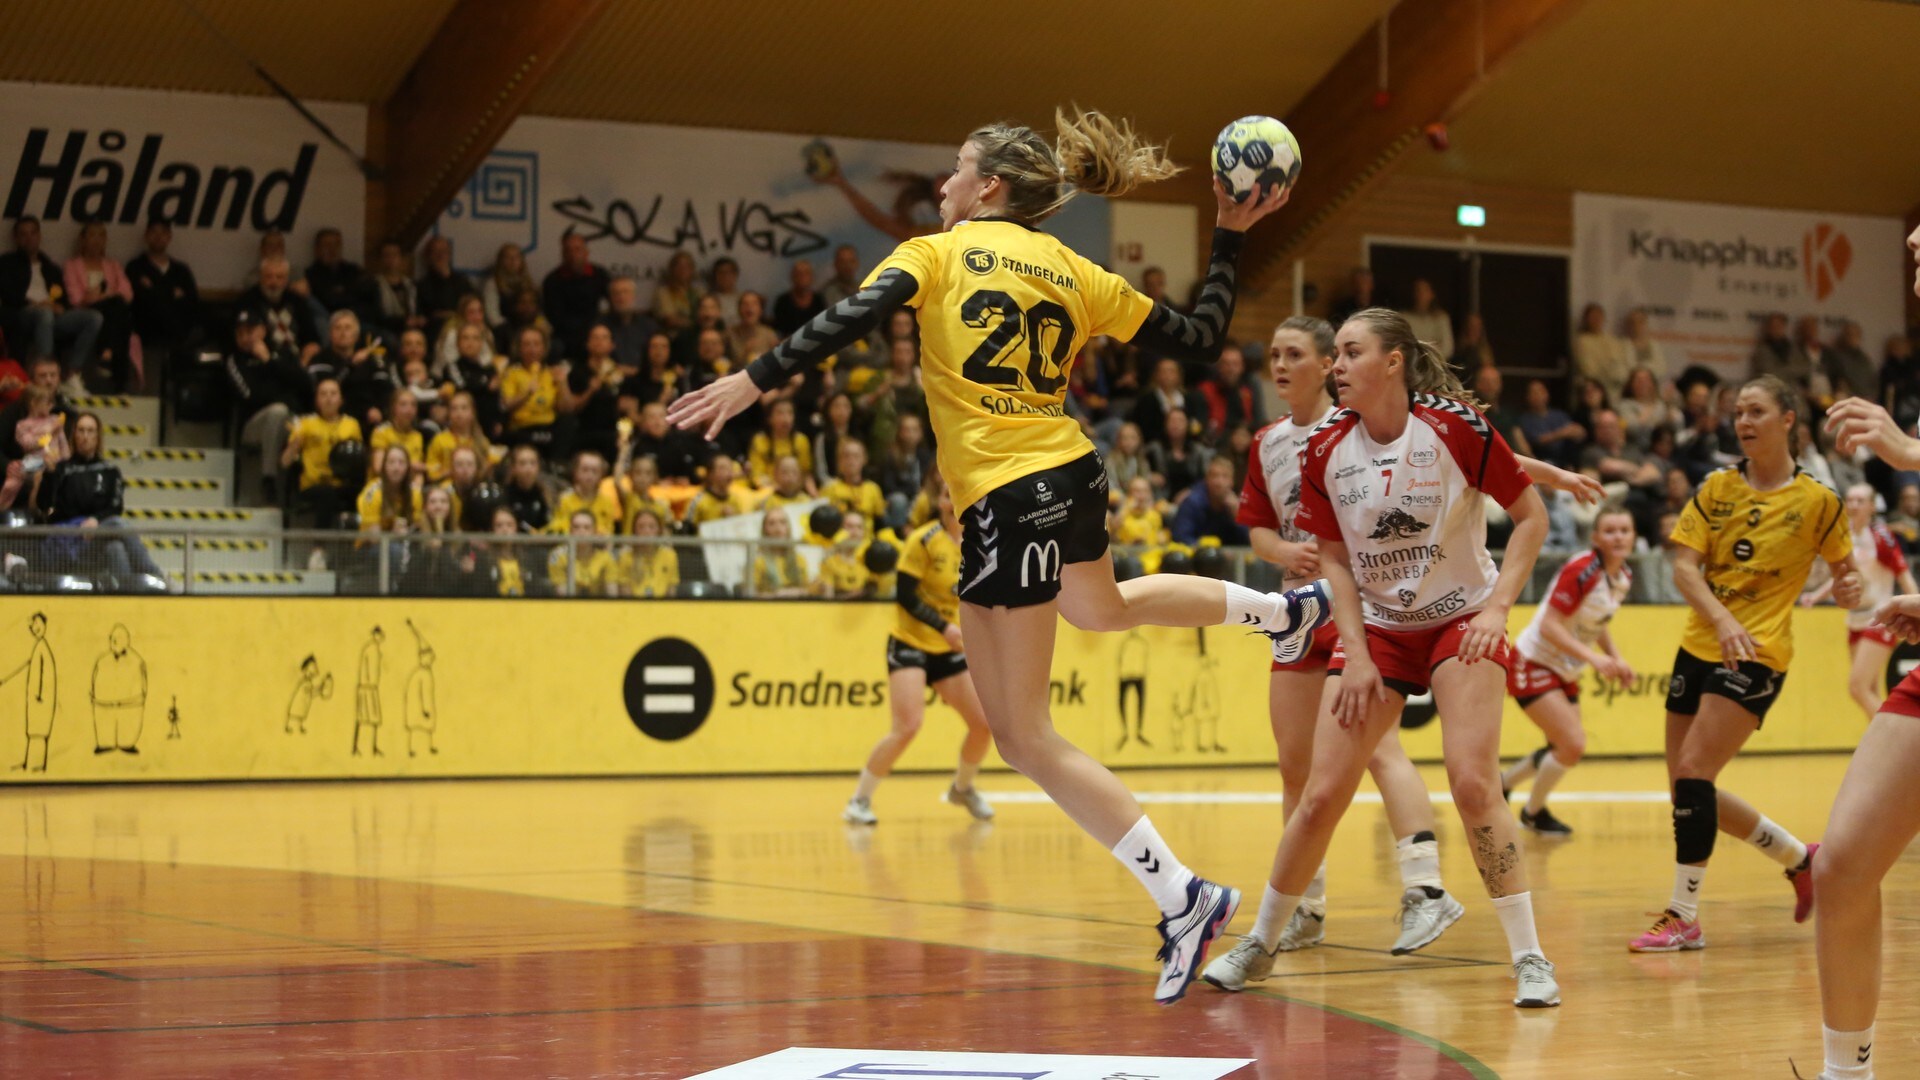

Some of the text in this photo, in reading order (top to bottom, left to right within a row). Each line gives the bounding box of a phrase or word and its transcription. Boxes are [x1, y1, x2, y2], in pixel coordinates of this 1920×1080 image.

[4, 127, 318, 233] Håland
[1628, 229, 1798, 270] Knapphus
[961, 289, 1076, 396] 20
[1381, 469, 1393, 497] 7
[1018, 507, 1049, 523] CLARION
[1048, 502, 1067, 513] HOTEL
[1412, 494, 1443, 504] NEMUS
[1034, 509, 1068, 526] STAVANGER
[1747, 507, 1761, 528] 3
[1357, 544, 1441, 570] Strømme
[1372, 592, 1467, 623] STRØMBERGS
[729, 670, 885, 708] Sandnes
